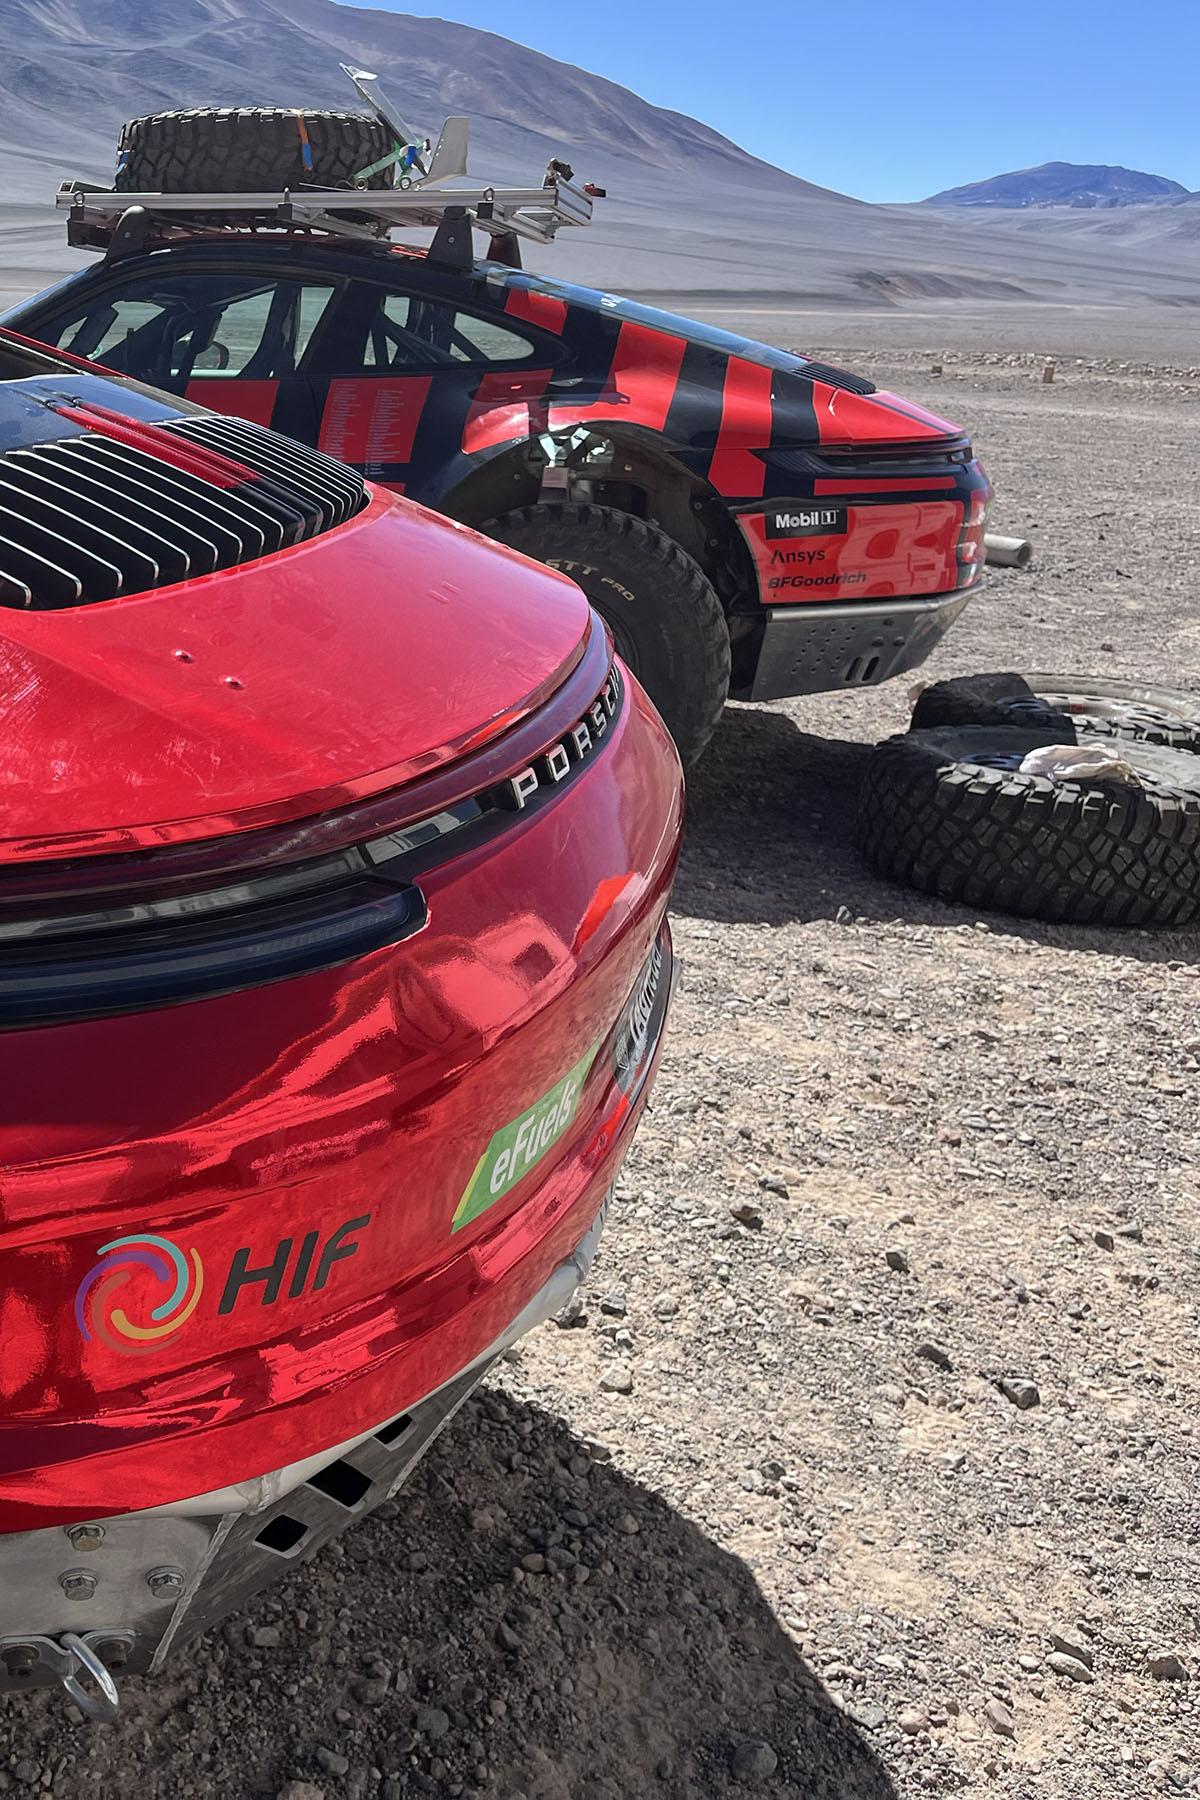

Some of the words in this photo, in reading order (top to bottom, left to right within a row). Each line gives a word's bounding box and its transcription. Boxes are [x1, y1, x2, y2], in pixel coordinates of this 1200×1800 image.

[776, 511, 818, 528] Mobil
[821, 509, 836, 525] 1
[771, 550, 825, 564] Ansys
[545, 559, 599, 576] STT
[601, 577, 635, 601] PRO
[768, 572, 867, 588] BFGoodrich
[489, 1079, 577, 1195] eFuels
[217, 1213, 371, 1315] HIF
